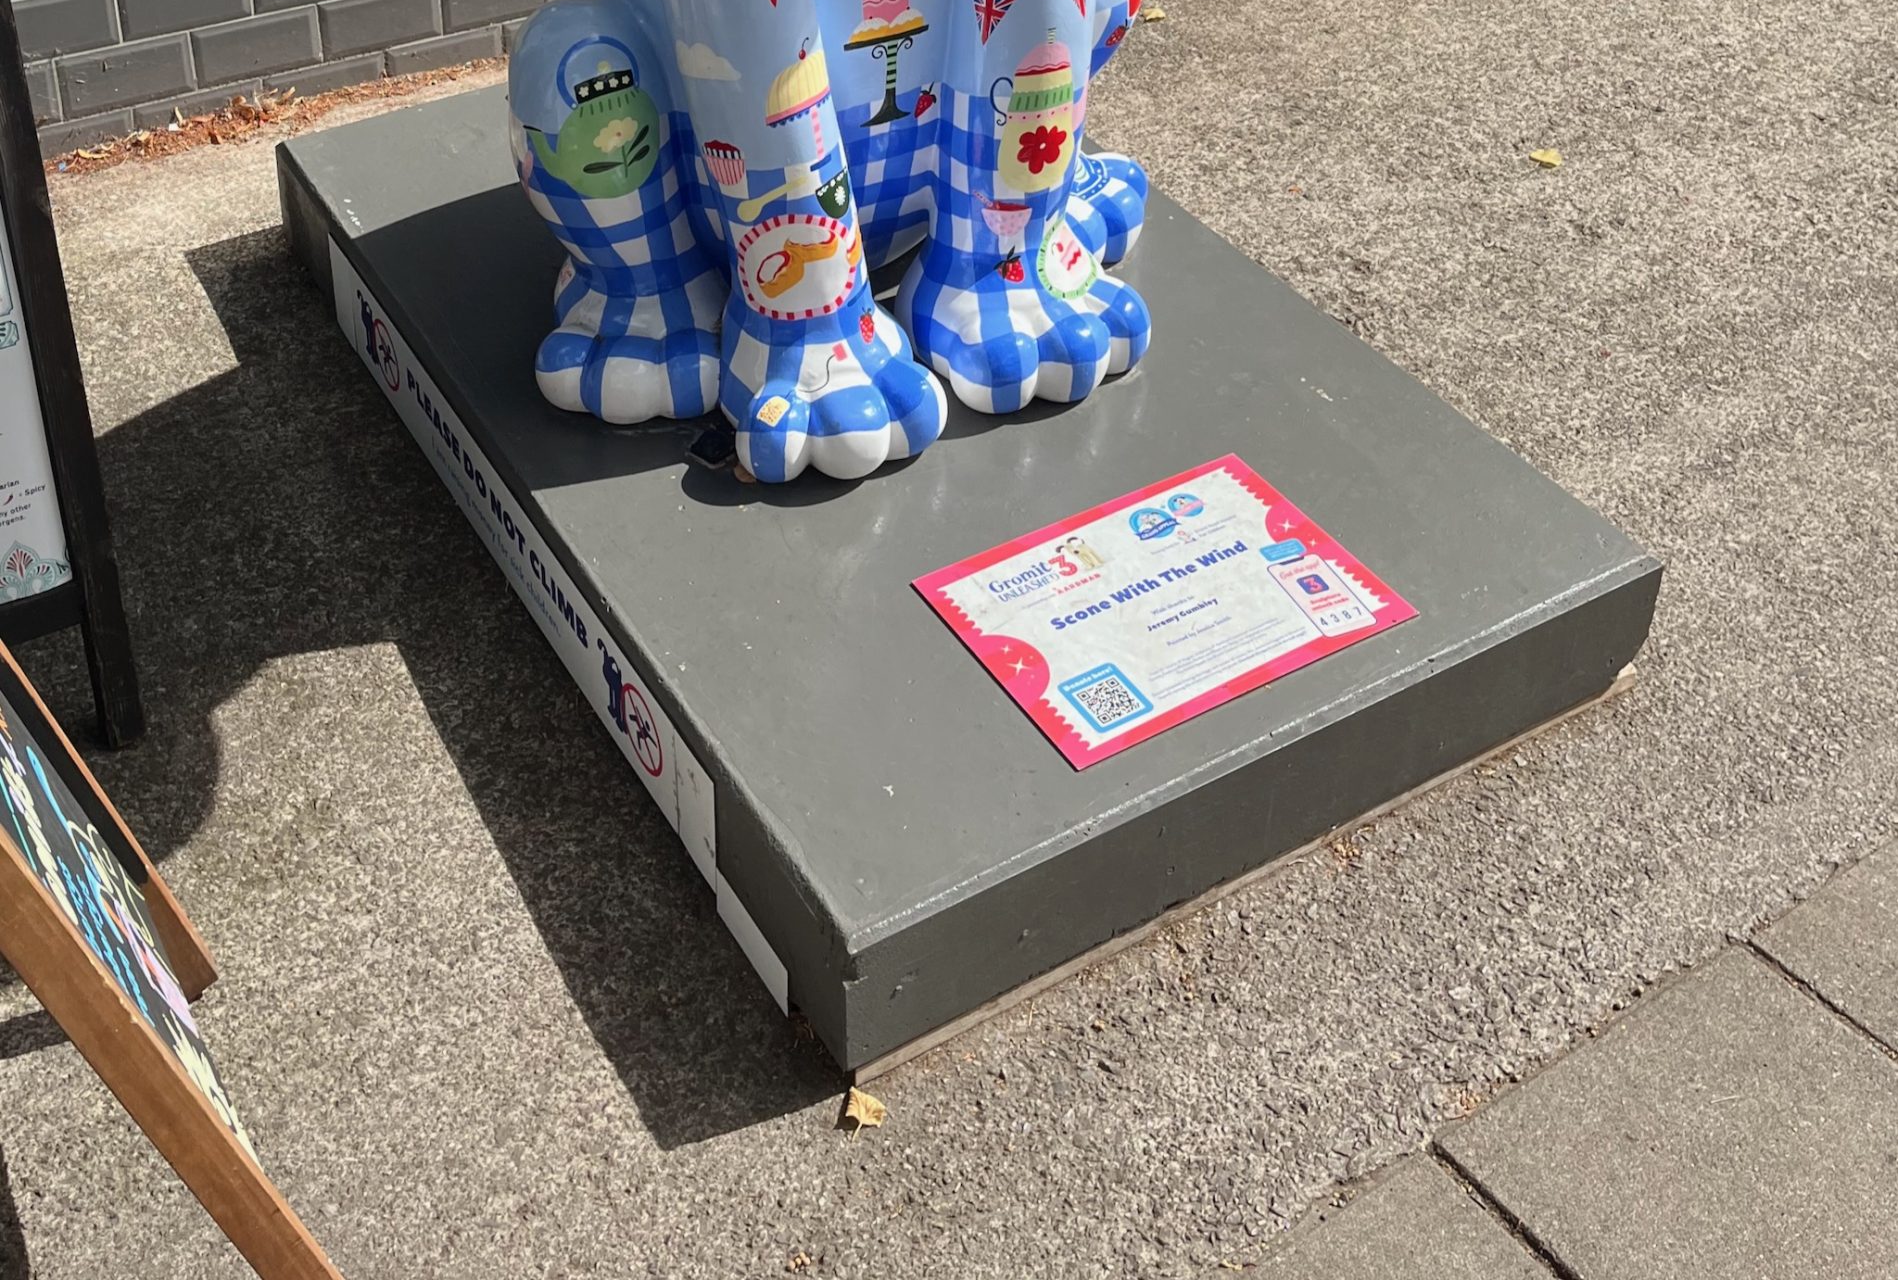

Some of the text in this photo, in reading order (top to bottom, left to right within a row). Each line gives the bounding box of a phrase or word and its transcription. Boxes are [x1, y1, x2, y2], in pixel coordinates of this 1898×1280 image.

[24, 484, 45, 496] Spicy
[10, 503, 31, 515] other
[407, 367, 588, 648] PLEASE DO NOT CLIMB
[988, 554, 1078, 594] Gromit 3
[1050, 601, 1112, 630] Scone
[1110, 577, 1160, 604] With
[1159, 562, 1200, 583] The
[1195, 540, 1249, 568] Wind
[1057, 573, 1101, 594] AARDMAN
[998, 573, 1060, 603] UNLEASHED
[1147, 616, 1181, 633] Jeremy
